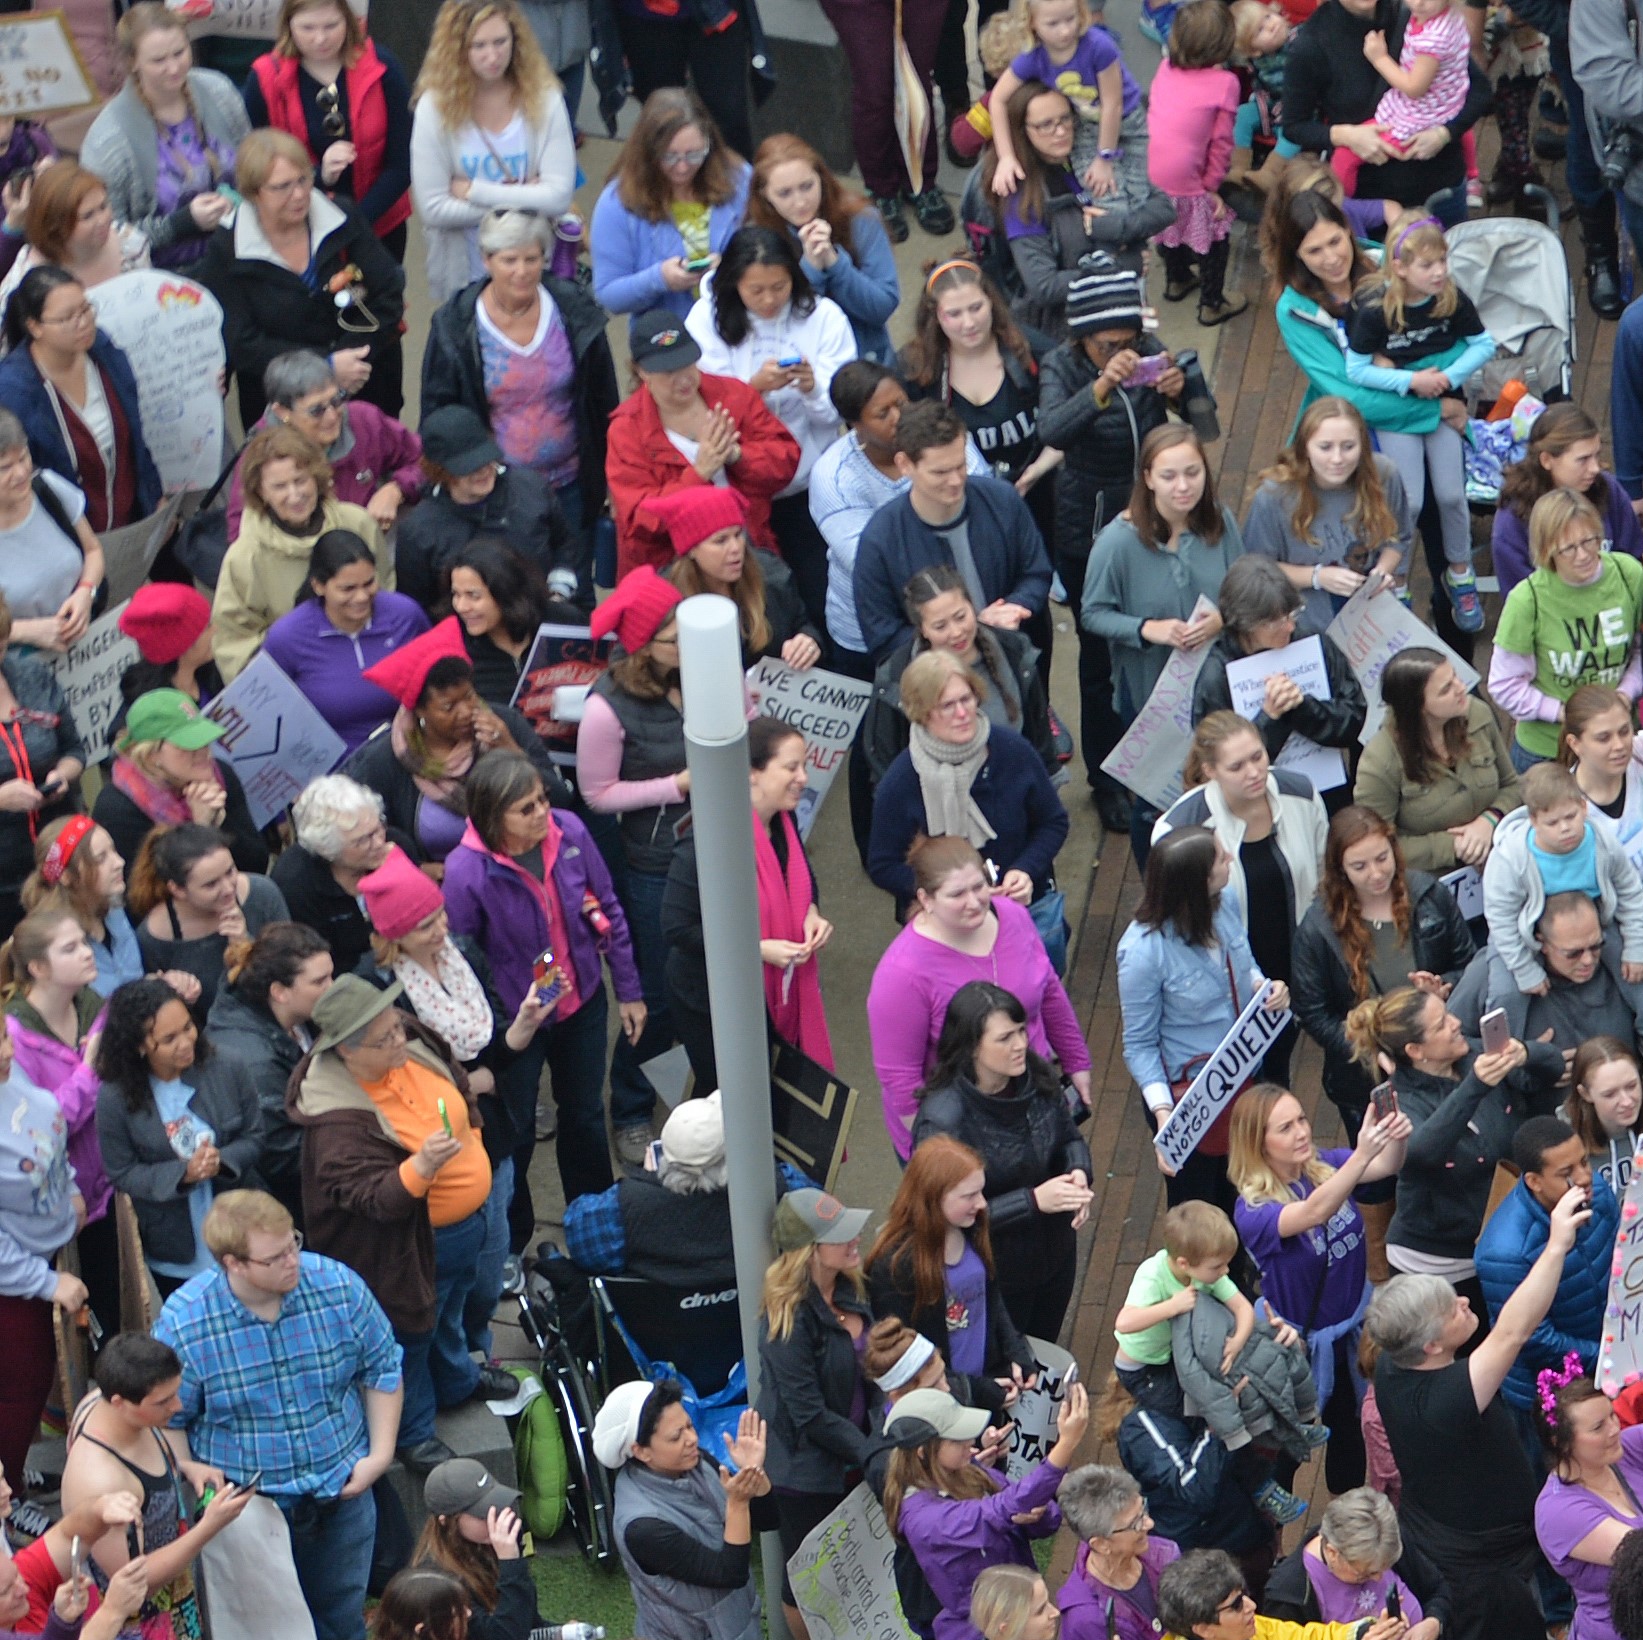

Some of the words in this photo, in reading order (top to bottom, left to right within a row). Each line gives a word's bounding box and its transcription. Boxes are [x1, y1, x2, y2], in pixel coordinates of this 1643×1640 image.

[1563, 606, 1630, 652] WE
[238, 677, 278, 711] MY
[757, 665, 790, 694] WE
[800, 677, 871, 714] CANNOT
[89, 700, 113, 728] BY
[764, 697, 852, 742] SUCCEED
[807, 741, 847, 773] ALF
[1158, 1115, 1179, 1140] WE
[1176, 1086, 1201, 1118] WILL
[837, 1517, 863, 1561] Birth
[852, 1557, 876, 1614] control
[851, 1601, 869, 1636] care
